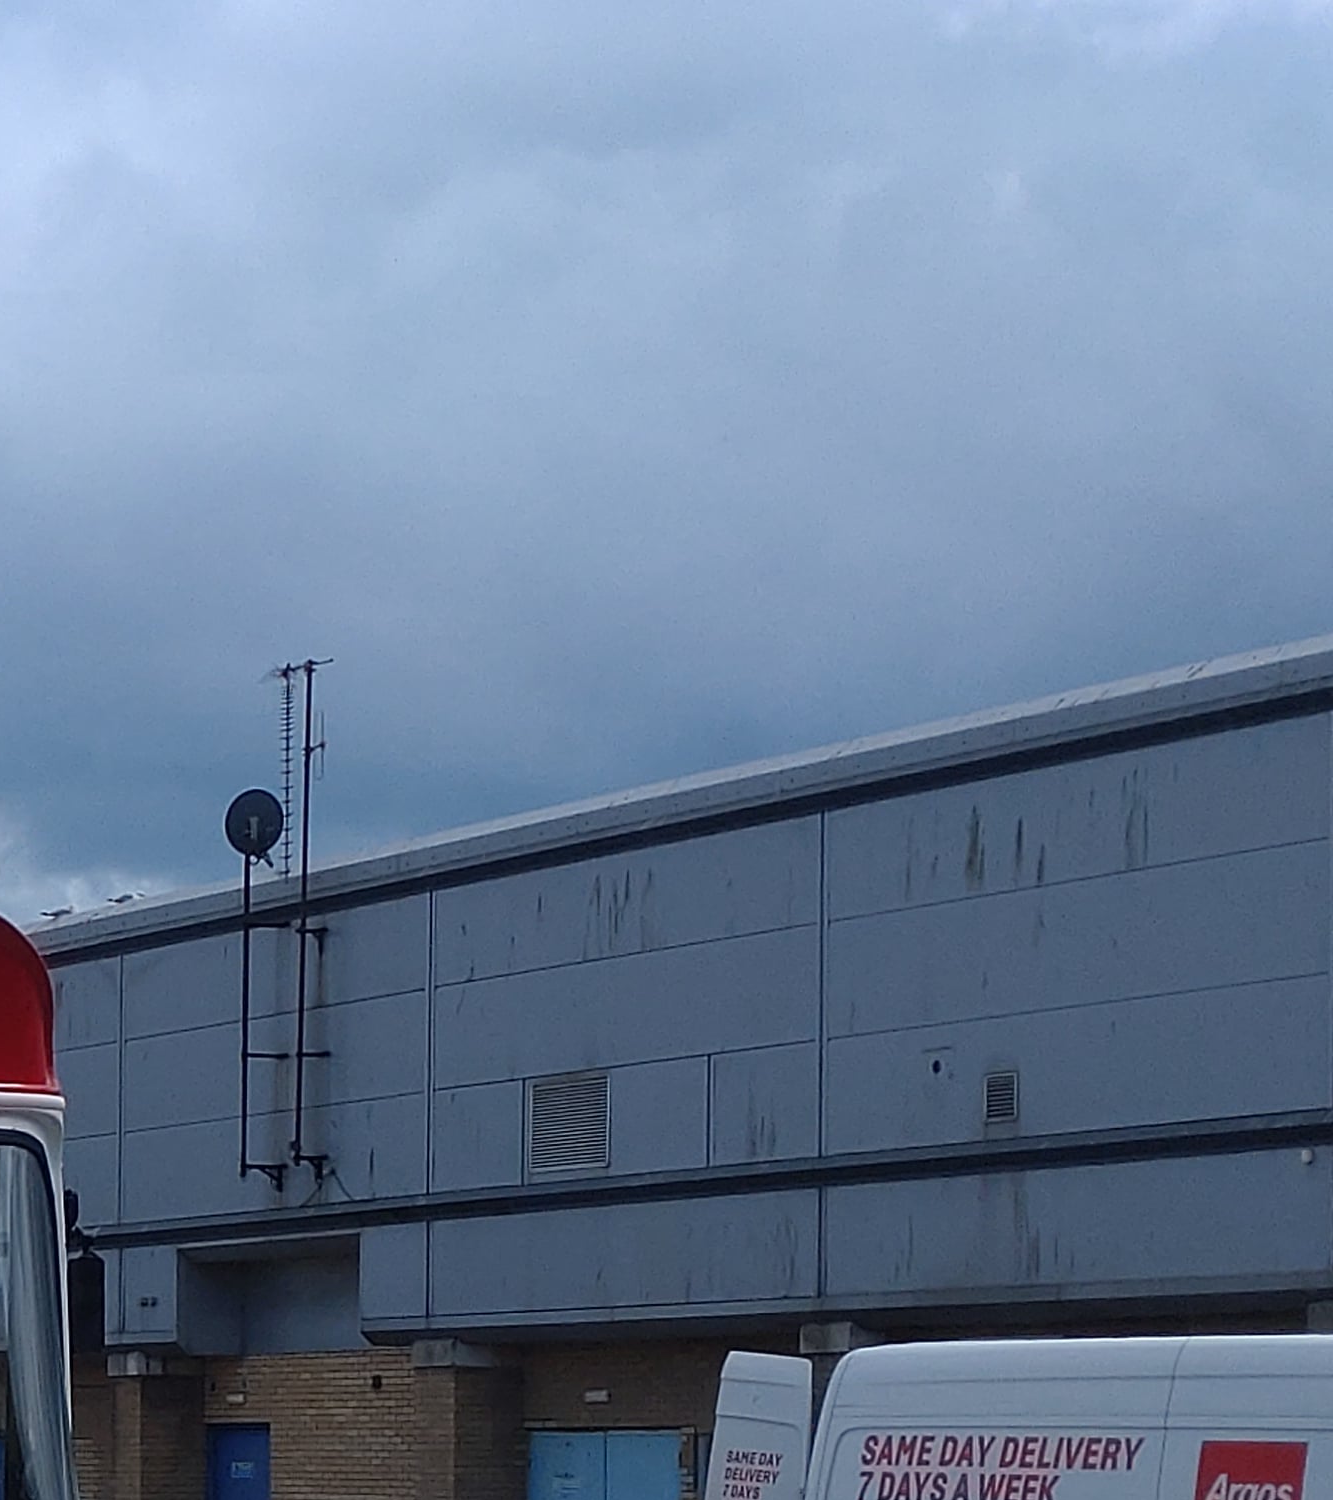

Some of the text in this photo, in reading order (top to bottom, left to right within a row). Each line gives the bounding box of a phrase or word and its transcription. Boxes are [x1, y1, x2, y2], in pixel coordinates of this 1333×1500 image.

[726, 1450, 783, 1467] SAME DAY
[861, 1435, 1145, 1471] SAME DAY DELIVERY
[724, 1467, 780, 1485] DELIVERY
[723, 1484, 761, 1500] 7 DAYS
